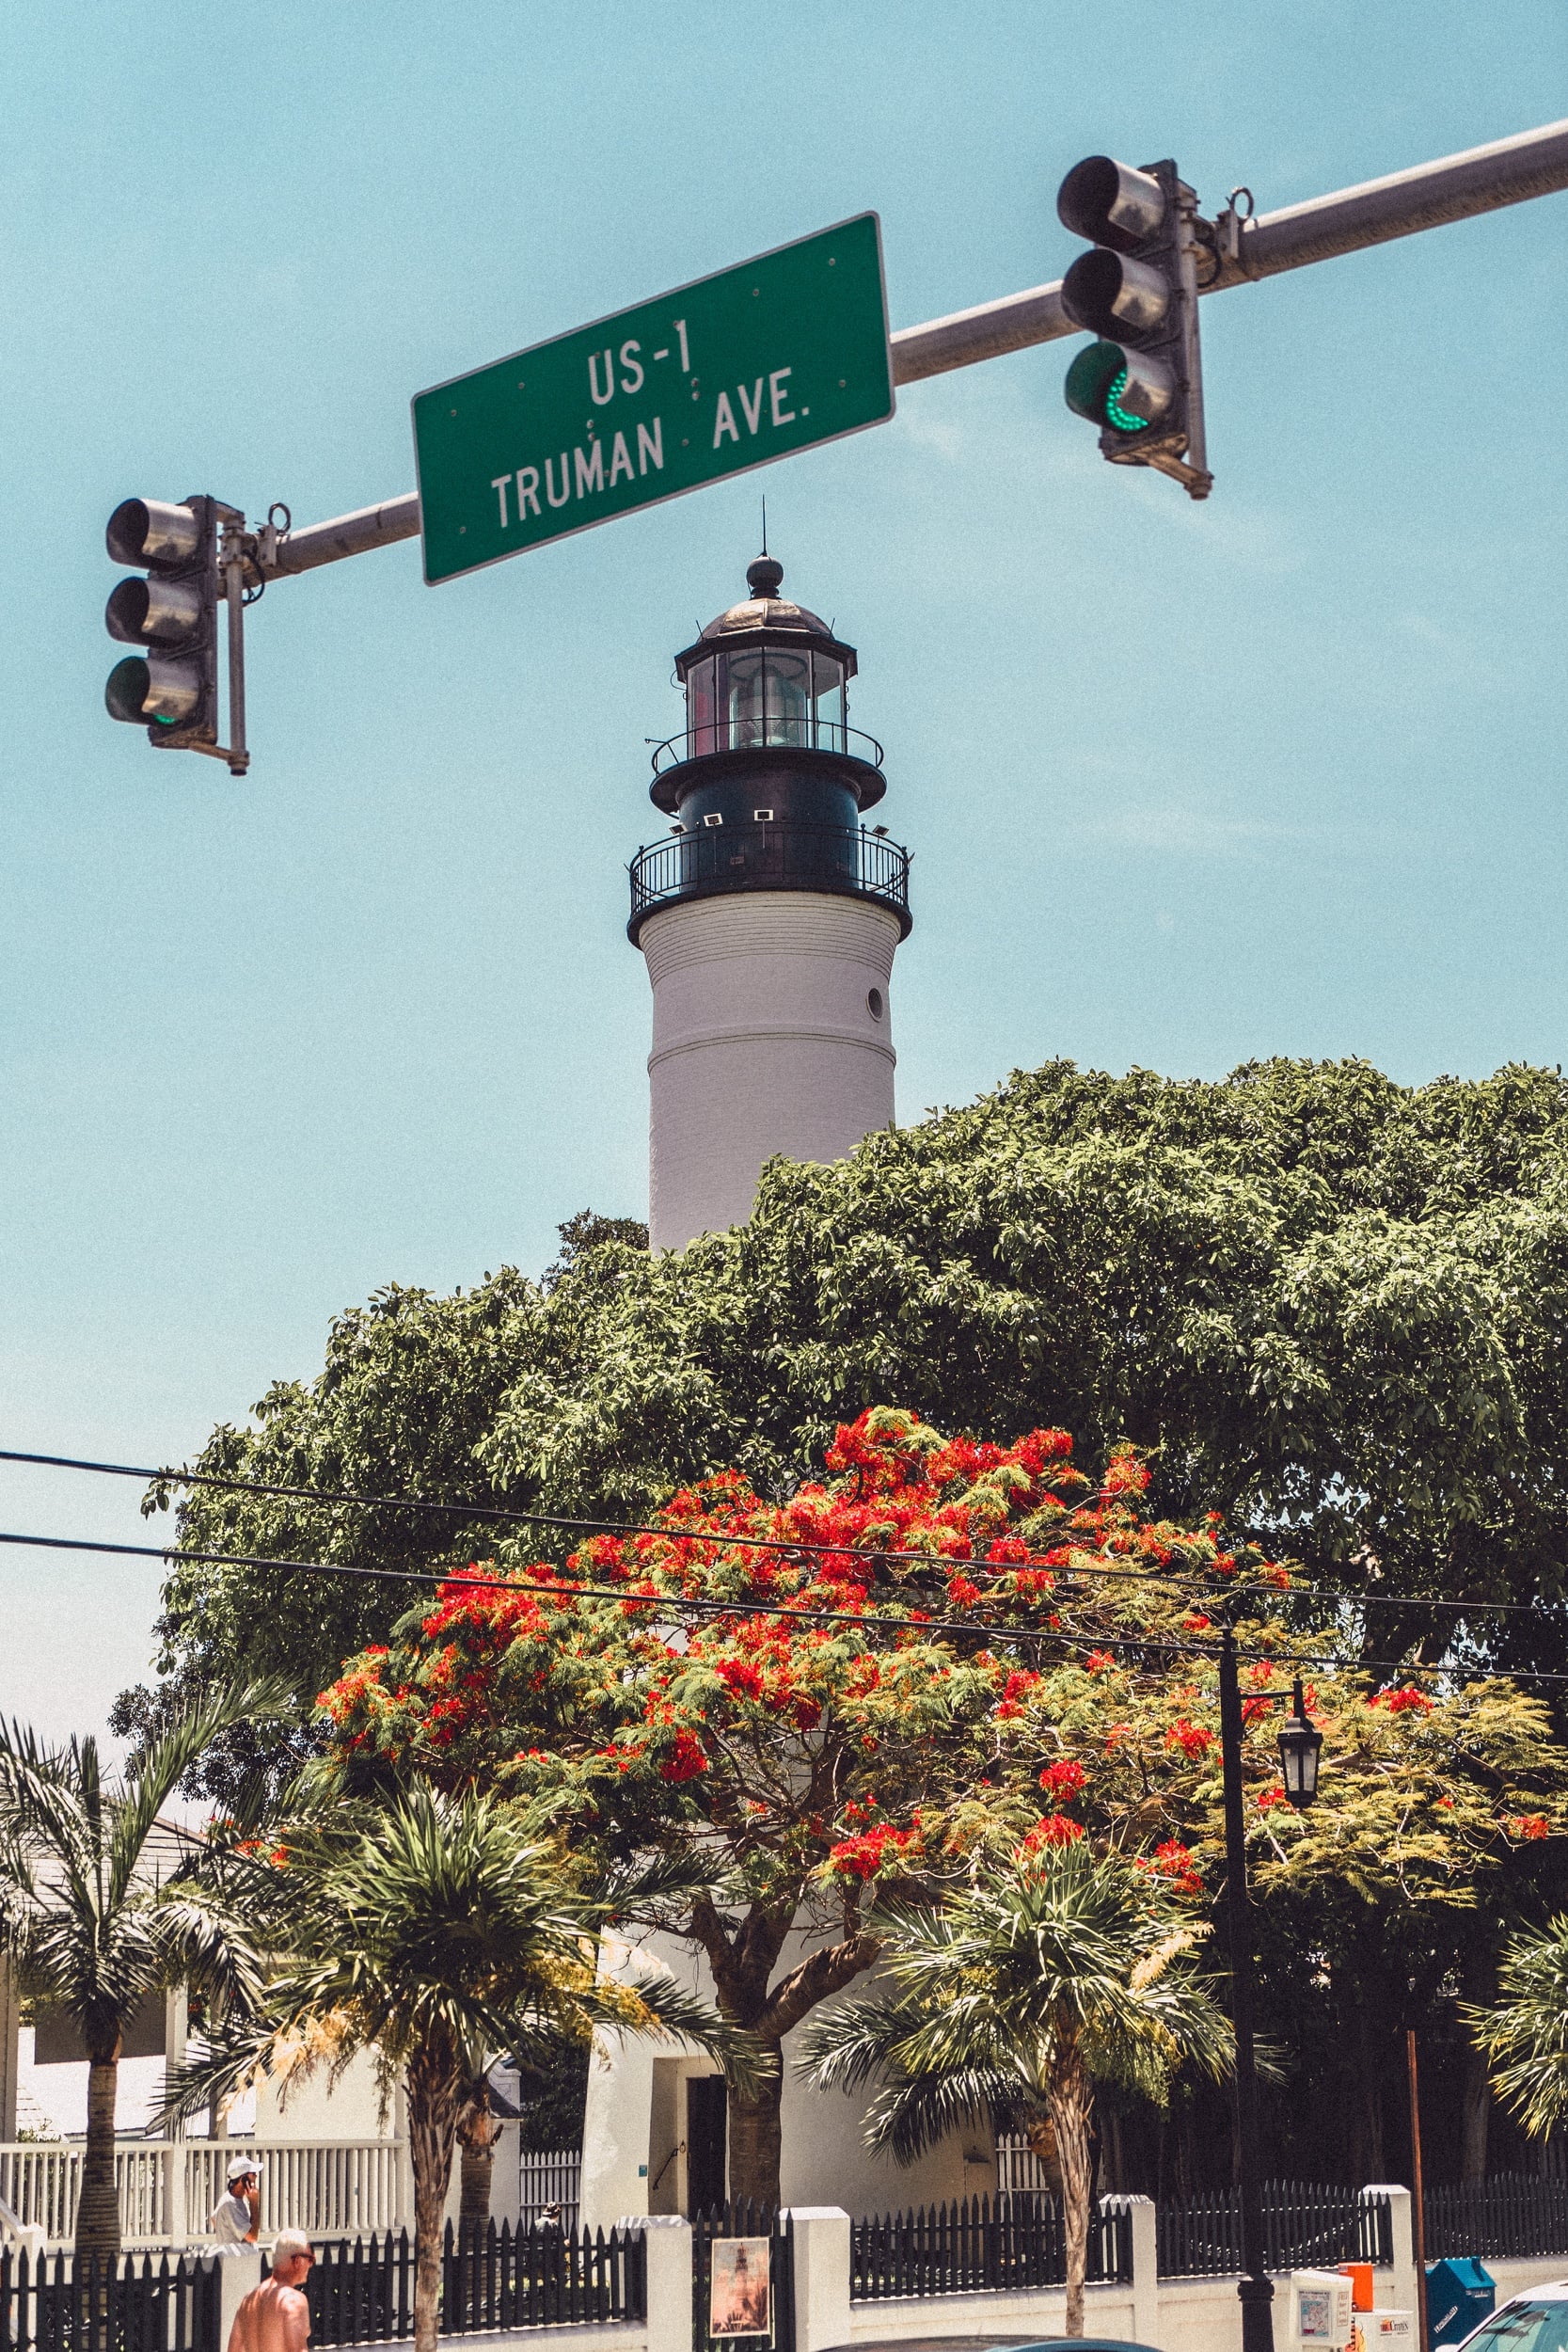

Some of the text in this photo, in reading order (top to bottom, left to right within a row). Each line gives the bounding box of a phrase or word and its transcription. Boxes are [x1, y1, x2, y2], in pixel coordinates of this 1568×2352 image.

[588, 320, 690, 405] US-1
[491, 367, 810, 529] TRUMAN AVE.
